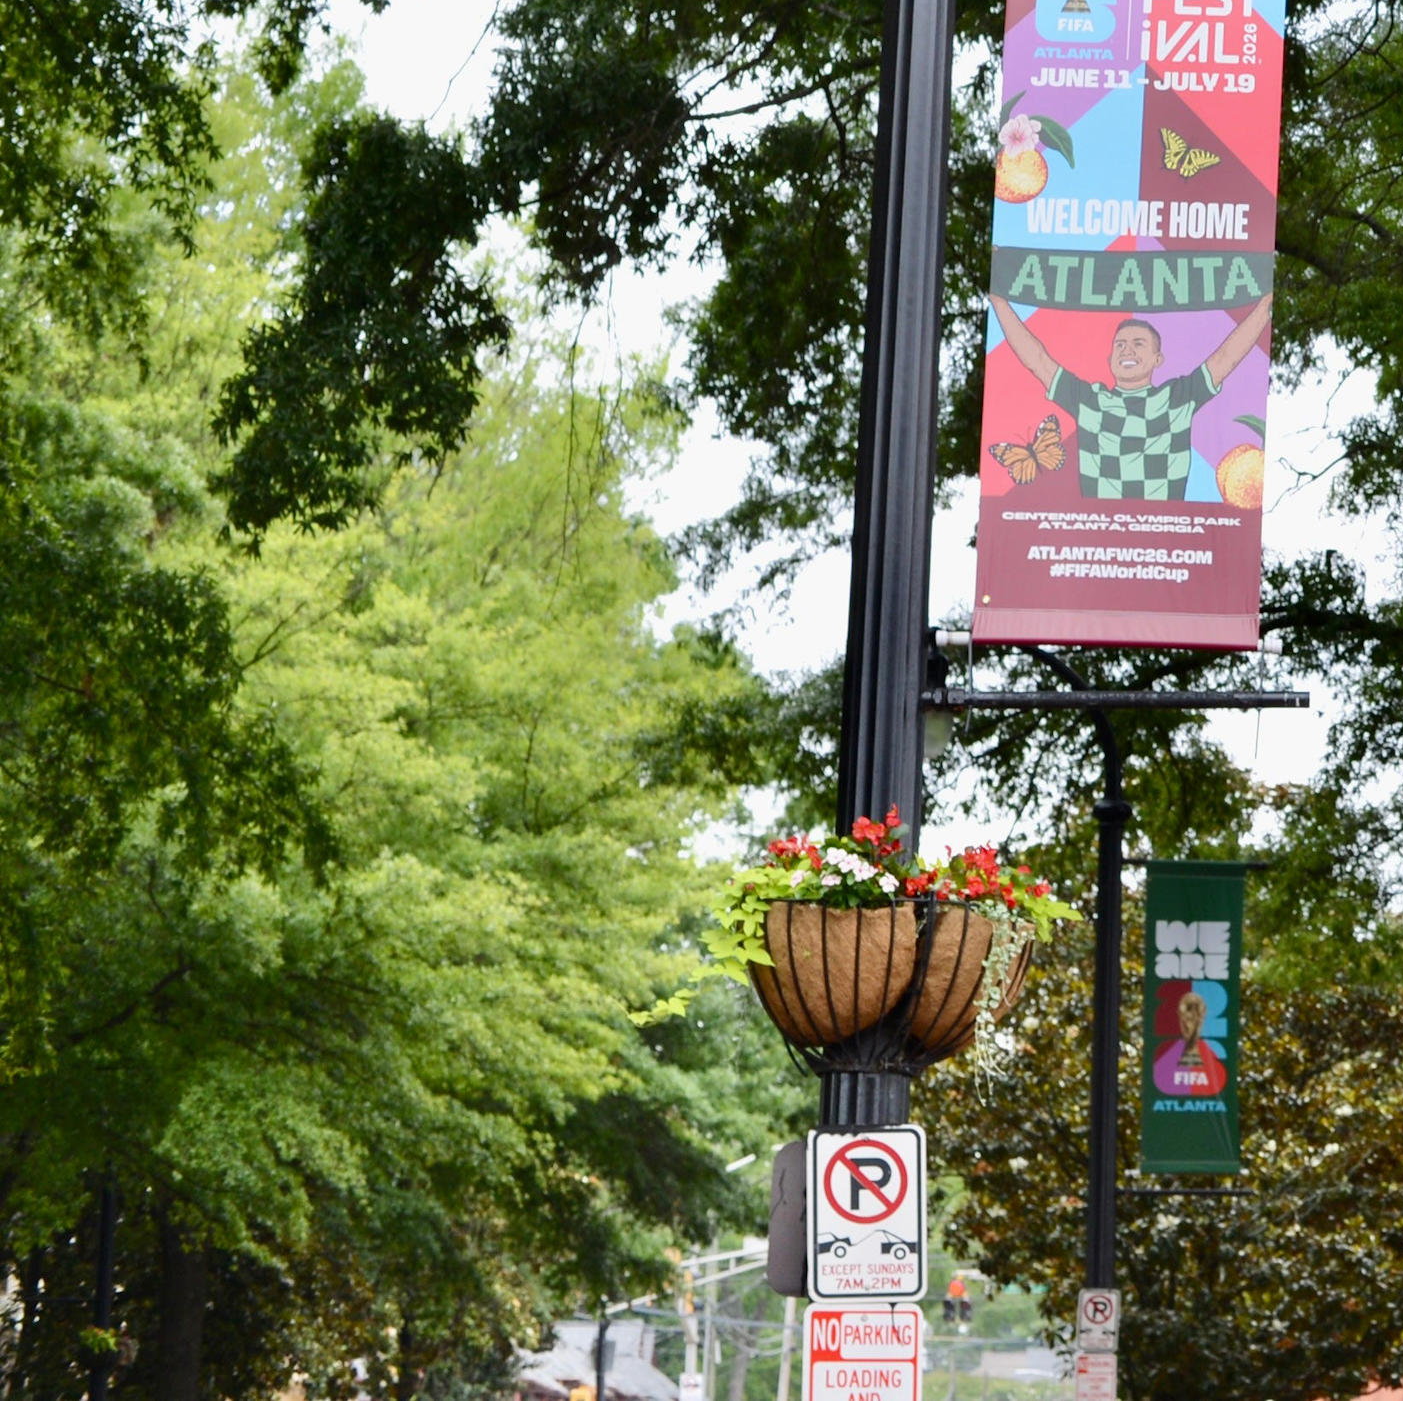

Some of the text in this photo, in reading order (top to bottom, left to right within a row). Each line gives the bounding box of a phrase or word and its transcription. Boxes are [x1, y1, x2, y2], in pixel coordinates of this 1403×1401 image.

[1057, 18, 1093, 32] FIFA
[1242, 23, 1258, 65] 2026
[1033, 46, 1114, 61] ATLANTA
[1030, 67, 1100, 88] JUNE
[1103, 69, 1133, 89] 11
[1153, 71, 1219, 92] JULY
[1223, 73, 1256, 94] 19
[1026, 198, 1250, 241] WELCOME HOME
[1008, 254, 1262, 307] ATLANTA
[1001, 511, 1242, 527] CENTENNIAL OLYMPIC PARK
[1038, 522, 1205, 534] ATLANTA, GEORGIA
[1027, 546, 1214, 565] ATLANTAFWC26.COM
[1049, 563, 1190, 583] #FIFAWorldCup
[1173, 1071, 1209, 1086] FIFA
[1153, 1100, 1227, 1112] ATLANTA
[822, 1262, 915, 1276] EXCEPT SUNDAYS
[835, 1278, 902, 1290] 7AM 2PM
[813, 1317, 912, 1352] NO PARKING
[825, 1368, 903, 1389] LOADING
